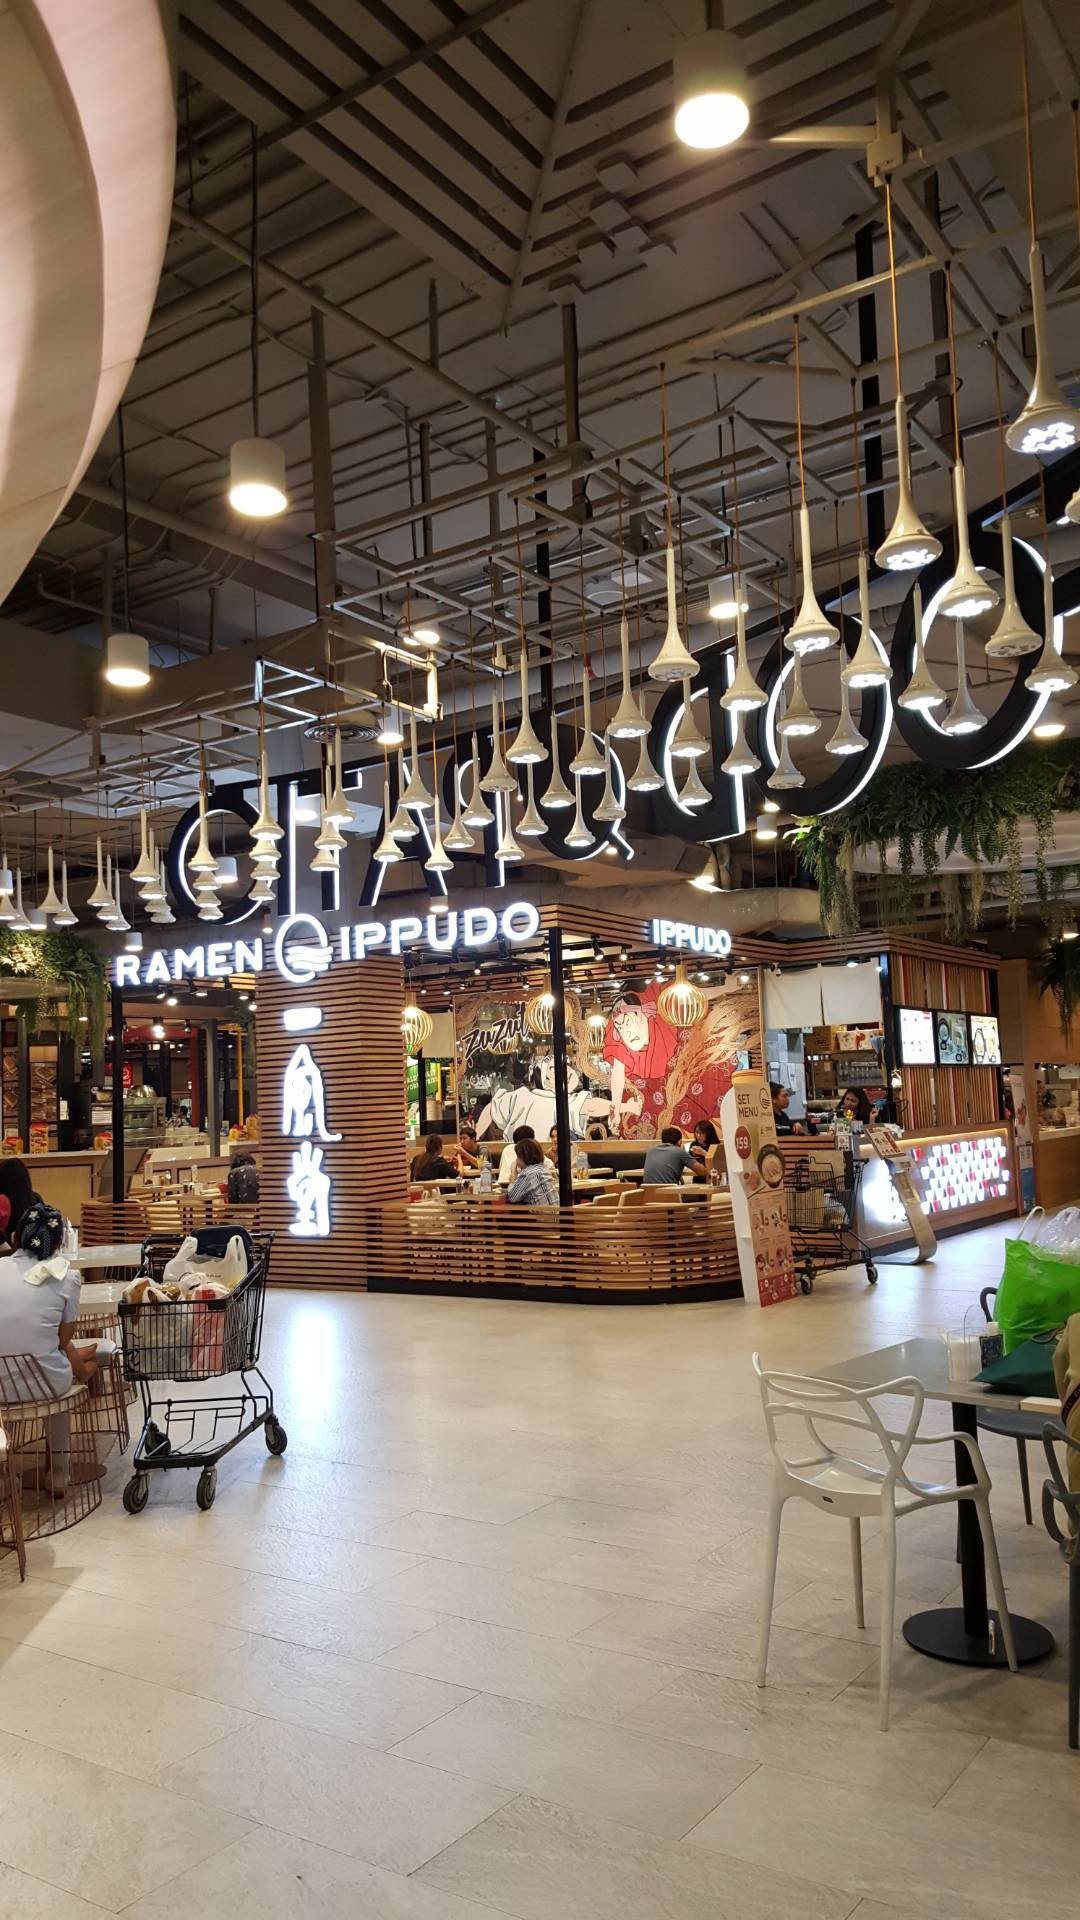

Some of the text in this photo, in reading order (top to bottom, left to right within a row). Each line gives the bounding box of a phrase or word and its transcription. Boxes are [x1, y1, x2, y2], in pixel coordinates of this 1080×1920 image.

[115, 902, 540, 987] RAMEN IPPUDO
[652, 918, 732, 955] IPPUDO
[737, 1094, 750, 1105] SET
[738, 1108, 759, 1118] MENU
